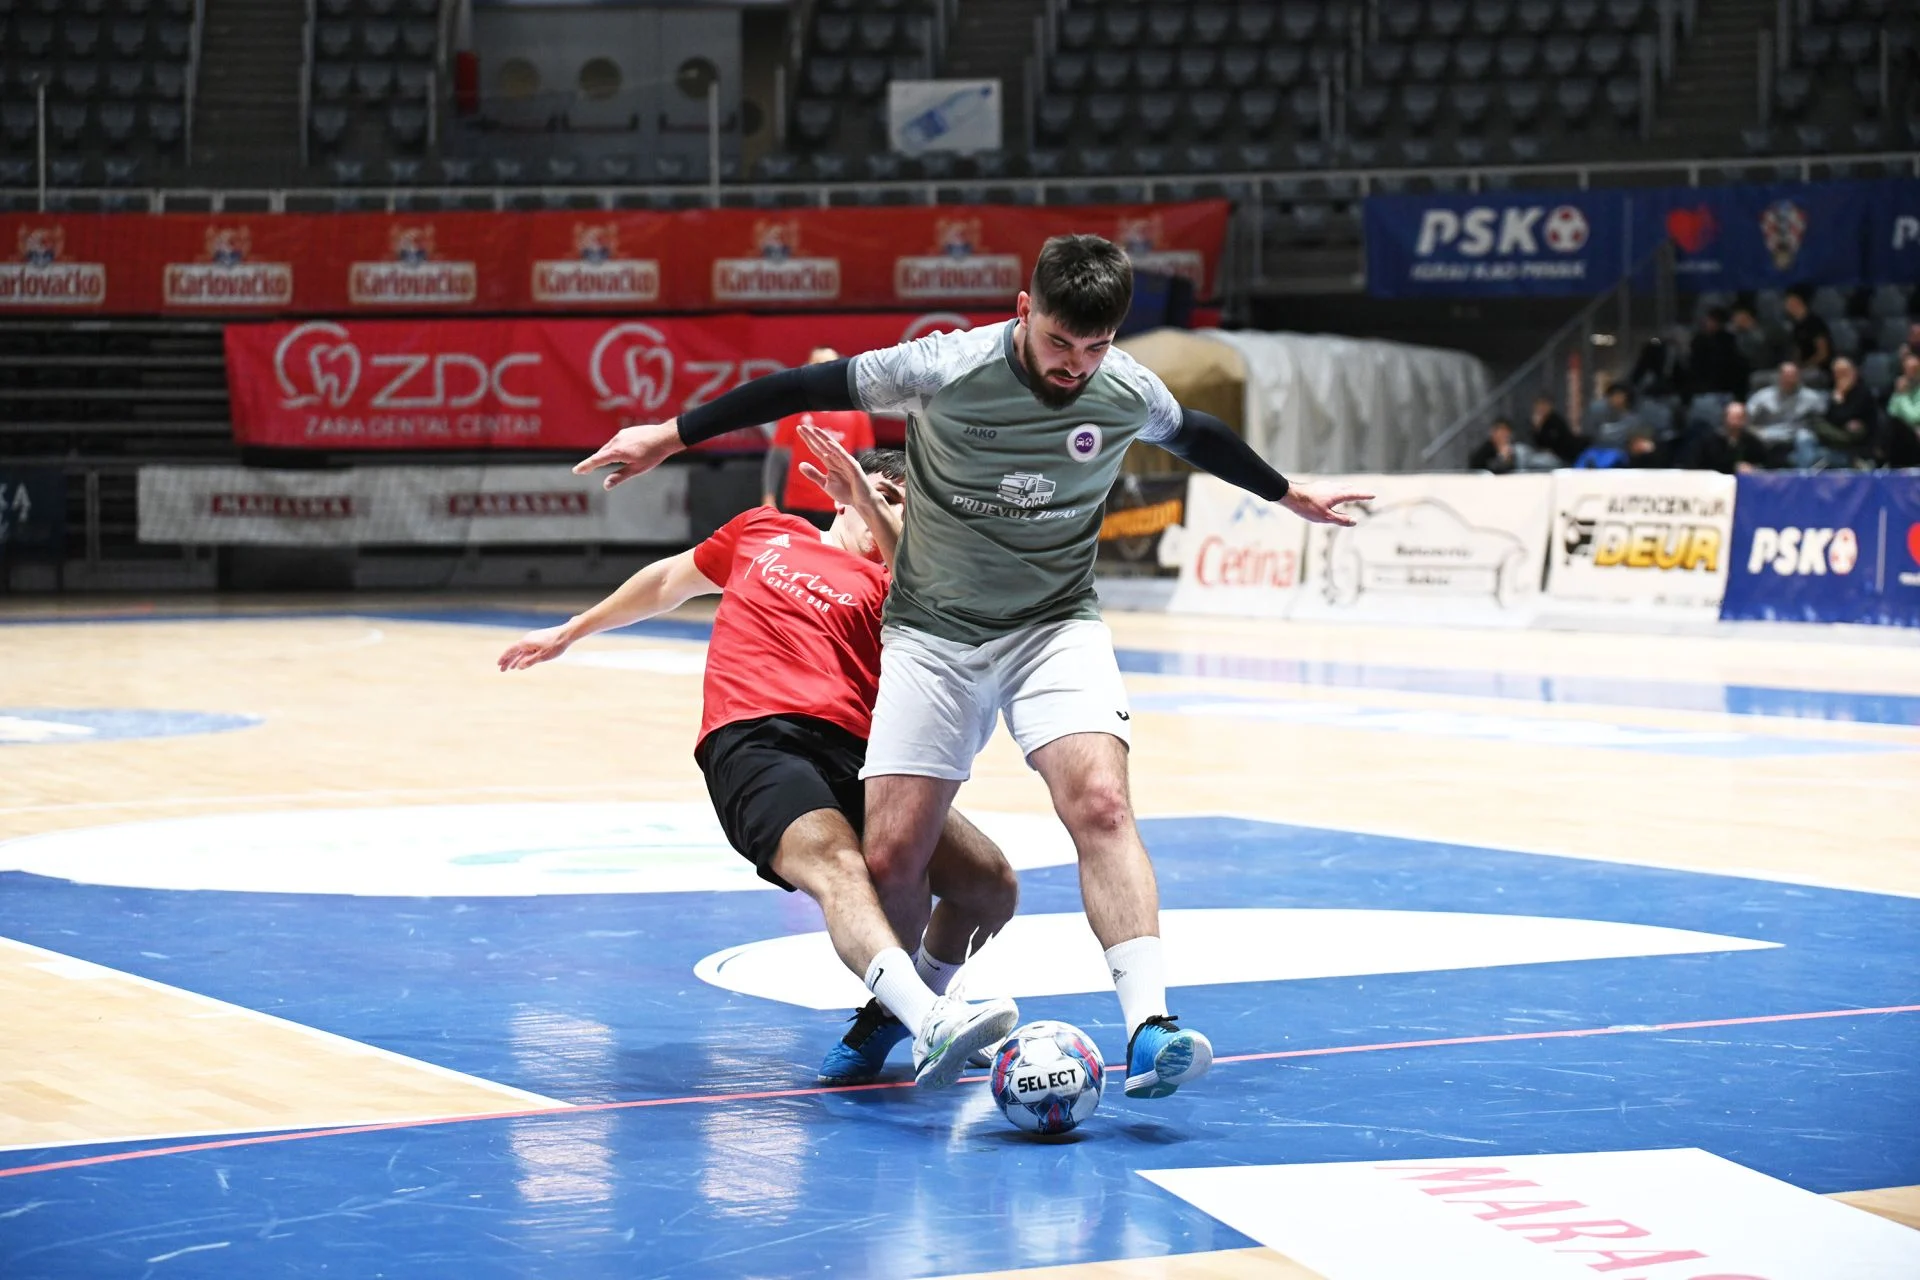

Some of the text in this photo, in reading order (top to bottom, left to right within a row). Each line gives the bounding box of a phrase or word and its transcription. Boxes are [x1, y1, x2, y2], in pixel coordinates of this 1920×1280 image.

[1416, 206, 1544, 256] PSK
[0, 266, 100, 296] arlovačko
[370, 353, 542, 408] ZDC
[963, 426, 997, 440] JAKO
[952, 495, 1031, 521] PRIJEVOZ
[1196, 534, 1296, 588] Cetina
[1593, 521, 1721, 573] DEUR
[1748, 526, 1834, 576] PSK
[766, 576, 831, 613] CAFFE BAR
[1017, 1069, 1077, 1093] SELECT
